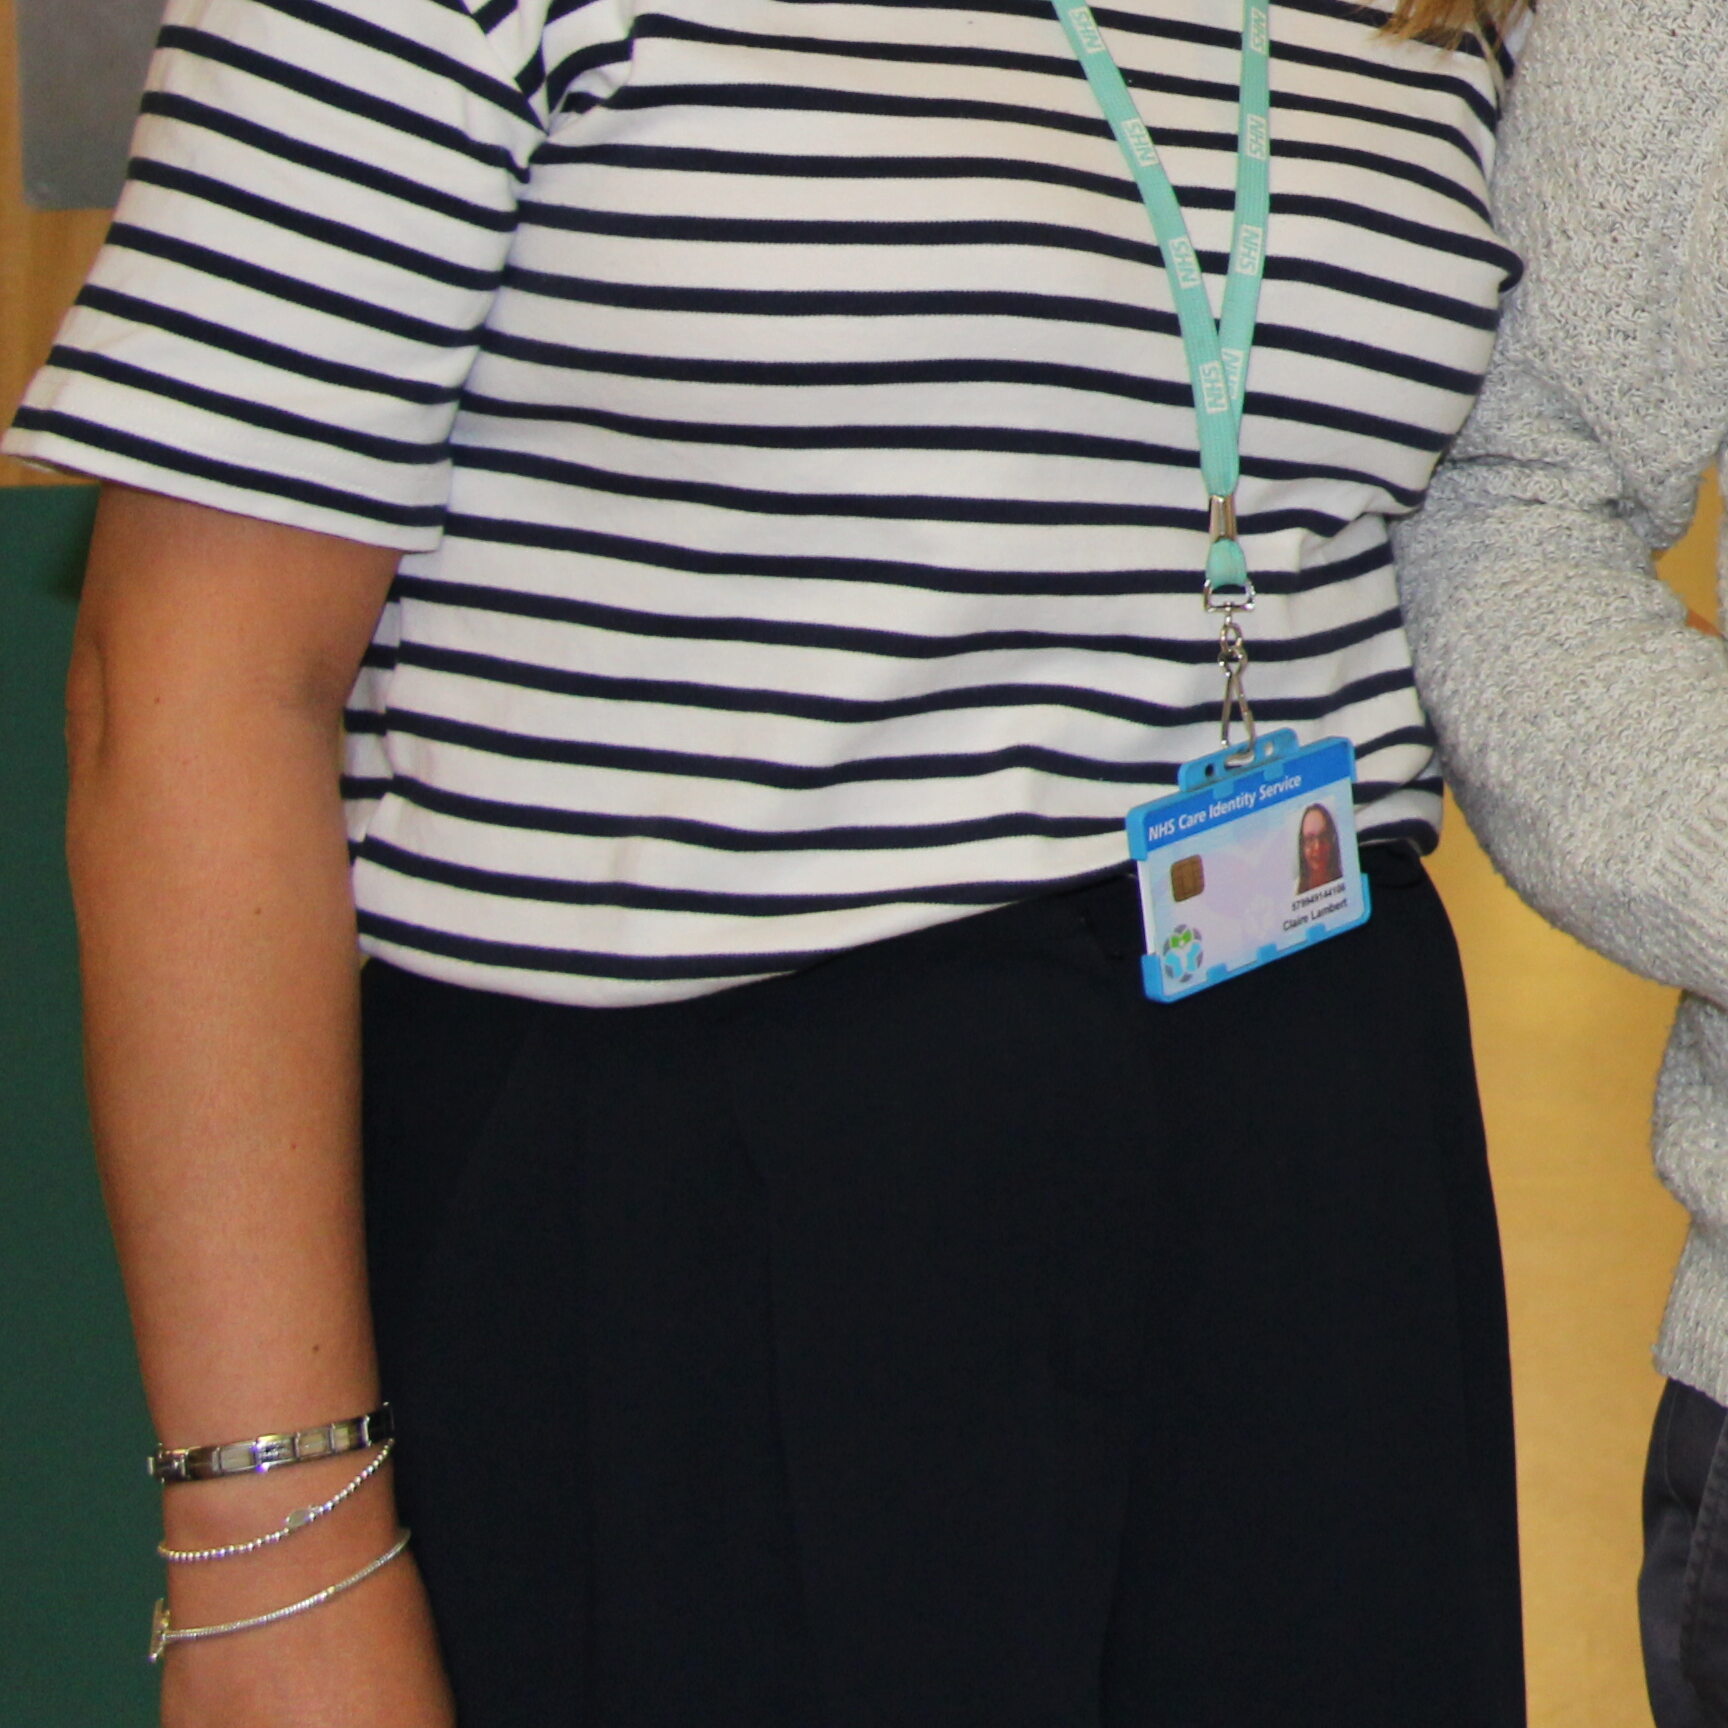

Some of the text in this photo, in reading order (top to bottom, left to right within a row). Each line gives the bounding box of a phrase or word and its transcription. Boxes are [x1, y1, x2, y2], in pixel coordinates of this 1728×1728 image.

[1074, 10, 1102, 50] NHS
[1252, 9, 1267, 54] NHS
[1129, 122, 1156, 164] NHS
[1249, 116, 1265, 159] NHS
[1174, 239, 1199, 284] NHS
[1239, 227, 1261, 273] NHS
[1202, 363, 1227, 409] NHS
[1149, 775, 1302, 841] NHS Care Identity Service
[1311, 897, 1348, 921] Lambert
